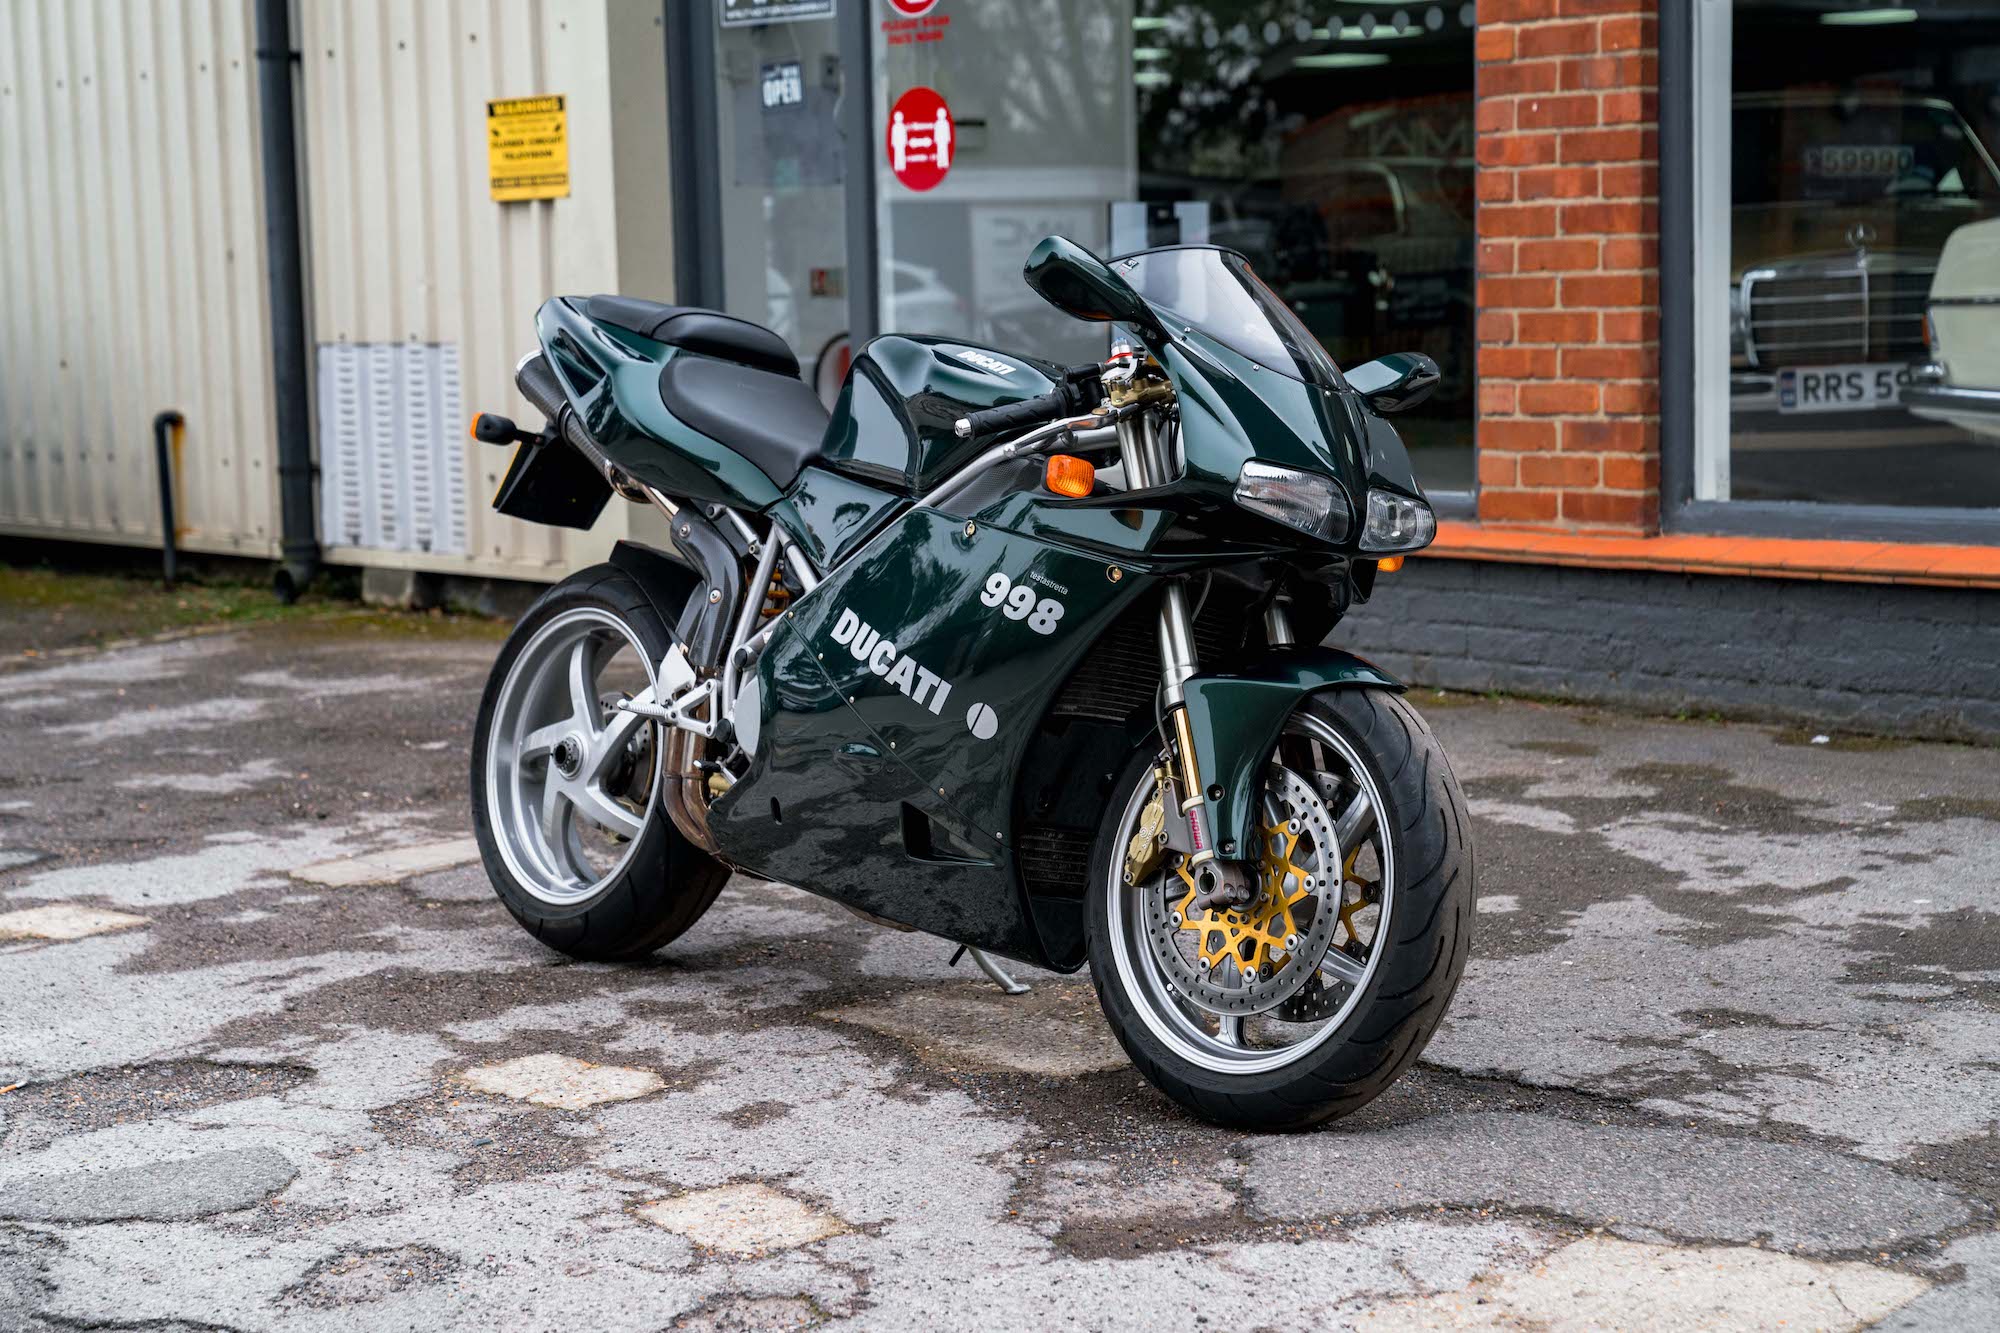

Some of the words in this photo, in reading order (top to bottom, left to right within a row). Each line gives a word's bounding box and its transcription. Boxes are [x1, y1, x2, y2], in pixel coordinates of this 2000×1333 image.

[763, 79, 802, 106] OPEN
[956, 351, 1017, 375] DUCATI
[1803, 372, 1864, 402] RRS
[1029, 571, 1069, 595] testastretta
[980, 572, 1065, 635] 998
[830, 607, 952, 716] DUCATI
[1190, 810, 1203, 849] SHOWA
